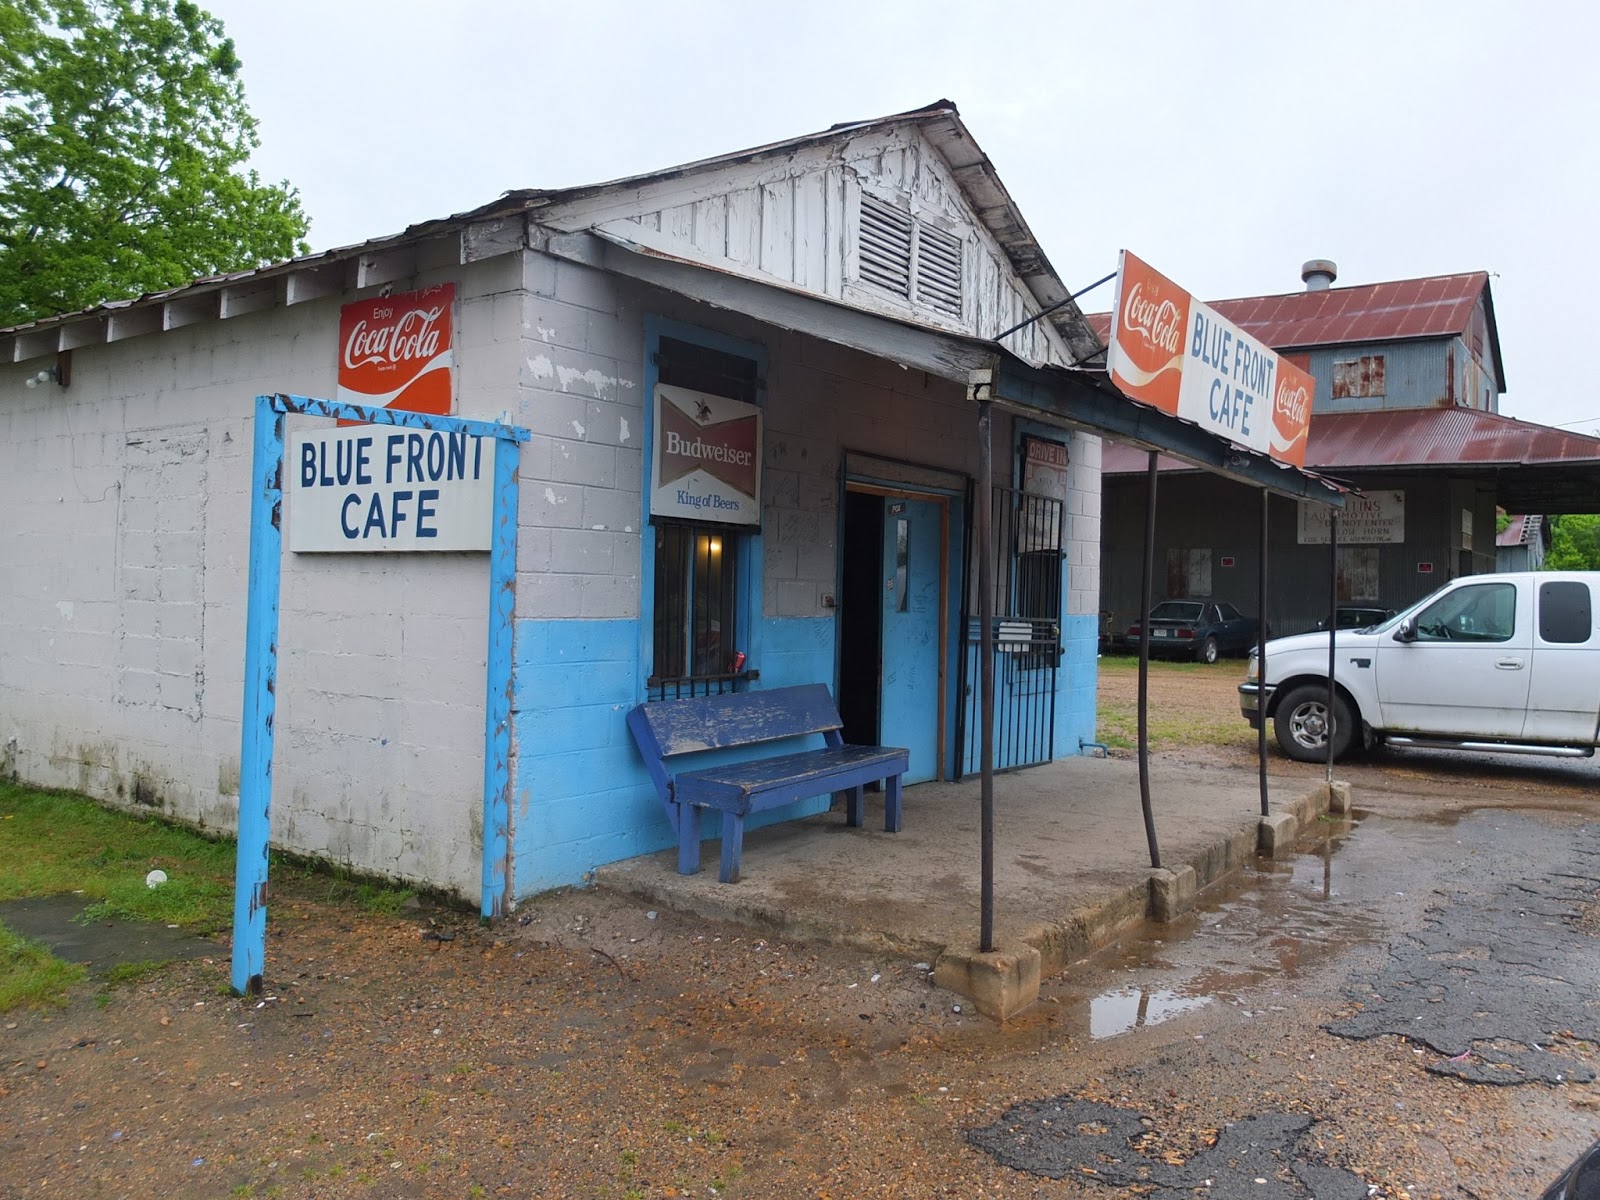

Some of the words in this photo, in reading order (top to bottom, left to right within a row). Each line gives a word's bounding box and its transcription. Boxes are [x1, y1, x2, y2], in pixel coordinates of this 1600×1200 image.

[345, 304, 446, 369] Coca-Cola
[373, 307, 393, 319] Enjoy
[1124, 282, 1182, 354] Coca-Cola
[1191, 312, 1232, 375] BLUE
[1233, 338, 1274, 400] FRONT
[1209, 378, 1253, 437] CAFE
[1277, 376, 1309, 424] Coca-Cola
[301, 437, 373, 488] BLUE
[386, 432, 483, 484] FRONT
[666, 431, 752, 466] Budweiser
[1029, 441, 1054, 462] DRIVE
[1056, 448, 1067, 465] IN
[341, 489, 440, 539] CAFE
[677, 490, 701, 508] King
[702, 494, 711, 507] of
[713, 495, 740, 511] Beers
[1342, 519, 1362, 527] NOT
[1365, 519, 1394, 527] ENTER
[1364, 527, 1390, 535] HORN
